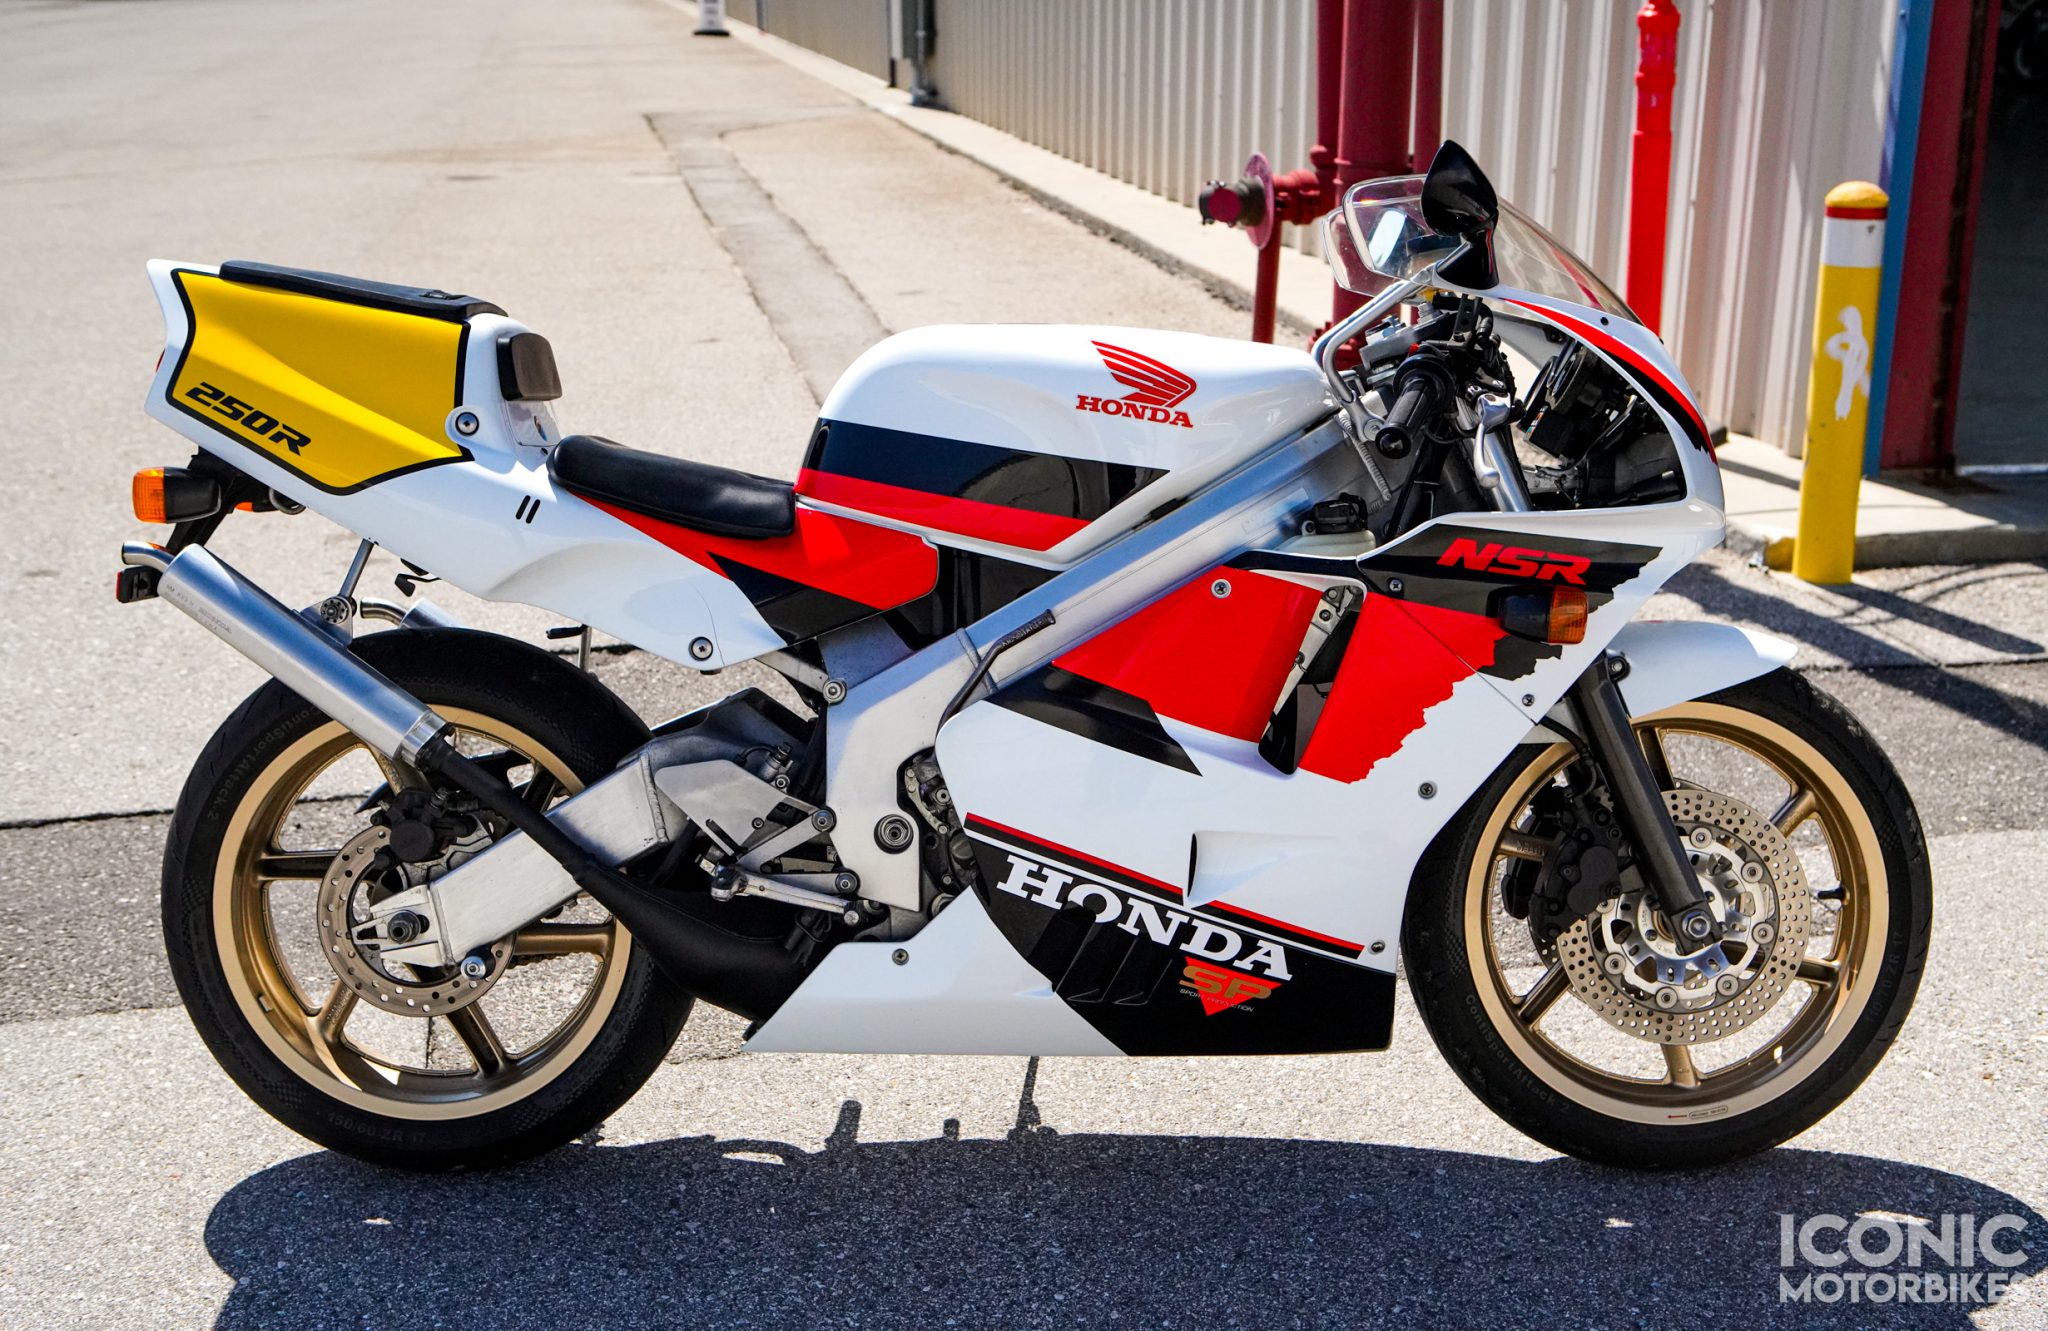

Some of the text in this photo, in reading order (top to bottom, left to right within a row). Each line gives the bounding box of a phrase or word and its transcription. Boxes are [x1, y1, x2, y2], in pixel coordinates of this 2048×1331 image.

[186, 382, 310, 456] 250R
[1076, 395, 1194, 429] HONDA
[1438, 538, 1591, 584] NSR
[997, 855, 1292, 981] HONDA
[1178, 964, 1272, 1000] SP
[1179, 988, 1204, 999] SPORT
[1465, 994, 1555, 1105] ContiSportAttack
